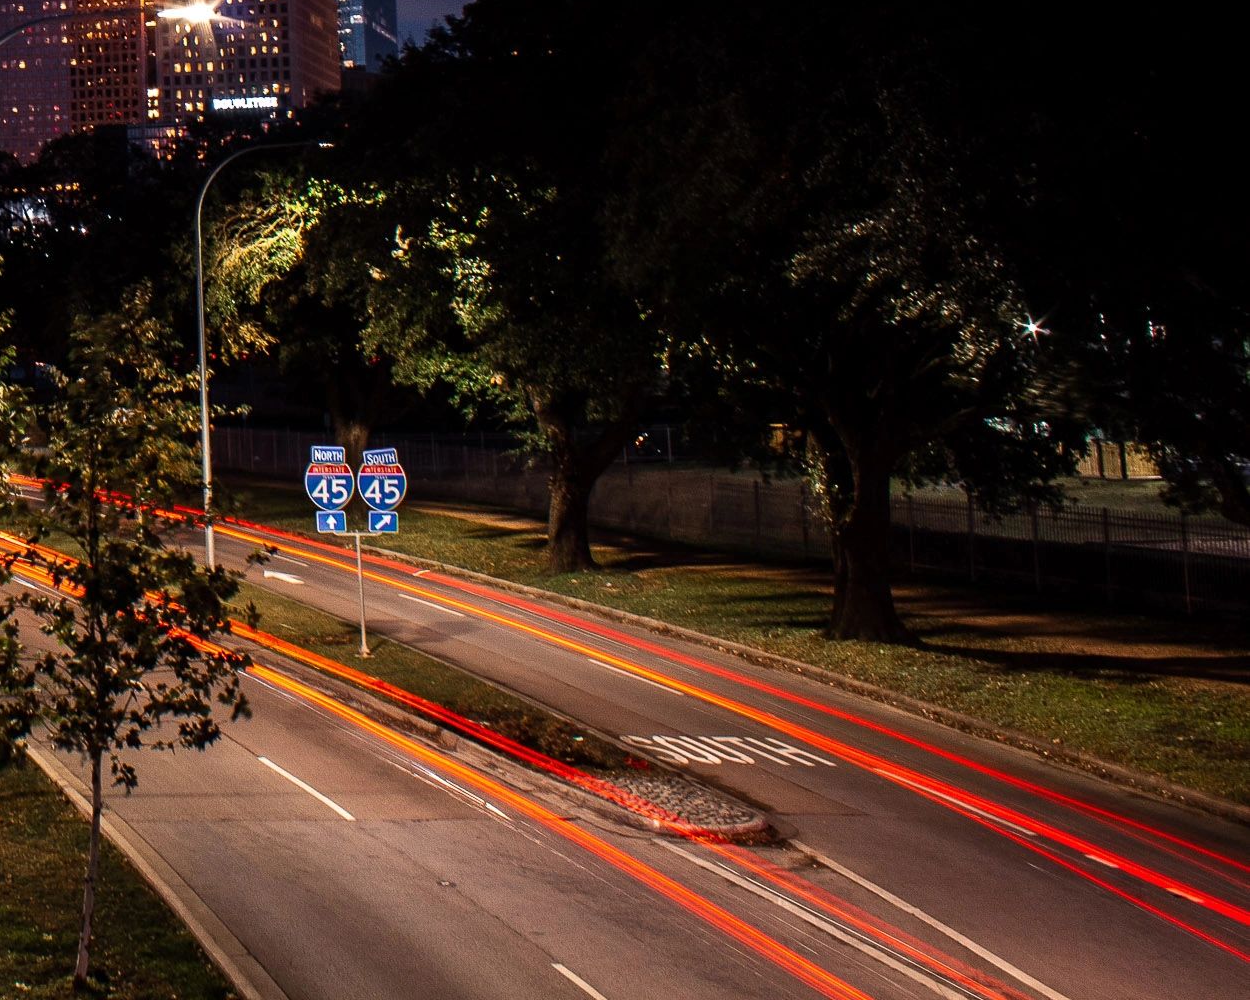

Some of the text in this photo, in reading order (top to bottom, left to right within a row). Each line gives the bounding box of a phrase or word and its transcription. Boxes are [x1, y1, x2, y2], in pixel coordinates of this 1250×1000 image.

[314, 449, 343, 461] NORTH
[366, 453, 395, 465] SOUTH
[311, 479, 348, 504] 45
[364, 479, 401, 504] 45
[619, 735, 838, 766] SOUTH
